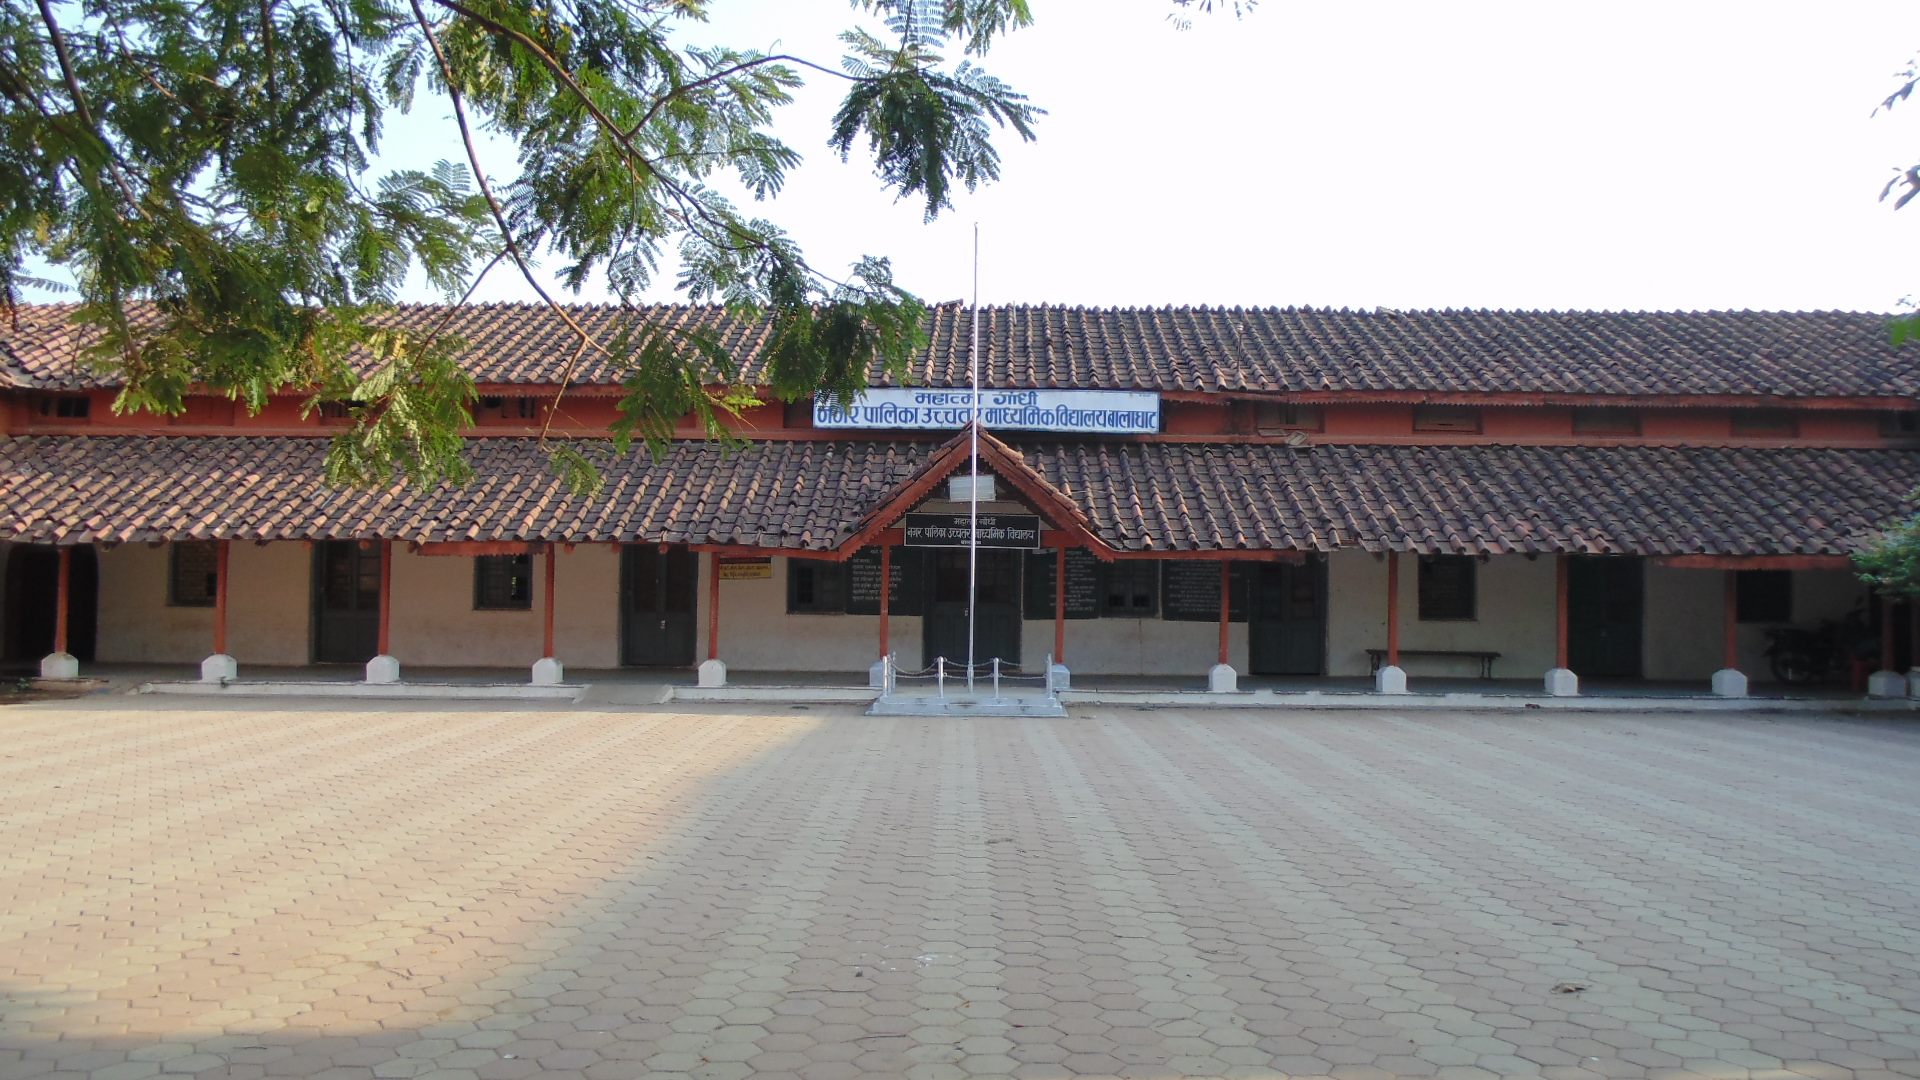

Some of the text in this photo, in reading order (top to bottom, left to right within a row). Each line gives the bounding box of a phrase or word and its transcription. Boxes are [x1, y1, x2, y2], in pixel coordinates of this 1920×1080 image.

[915, 391, 1038, 405] महात्मा गांधी
[864, 402, 920, 424] पालिका
[985, 405, 1053, 426] माध्यमिक
[1056, 404, 1108, 428] विद्यालय
[1108, 410, 1157, 429] बालाघाट
[907, 527, 922, 538] नगर
[924, 525, 946, 538] पालिका
[1007, 527, 1035, 540] विद्यालय
